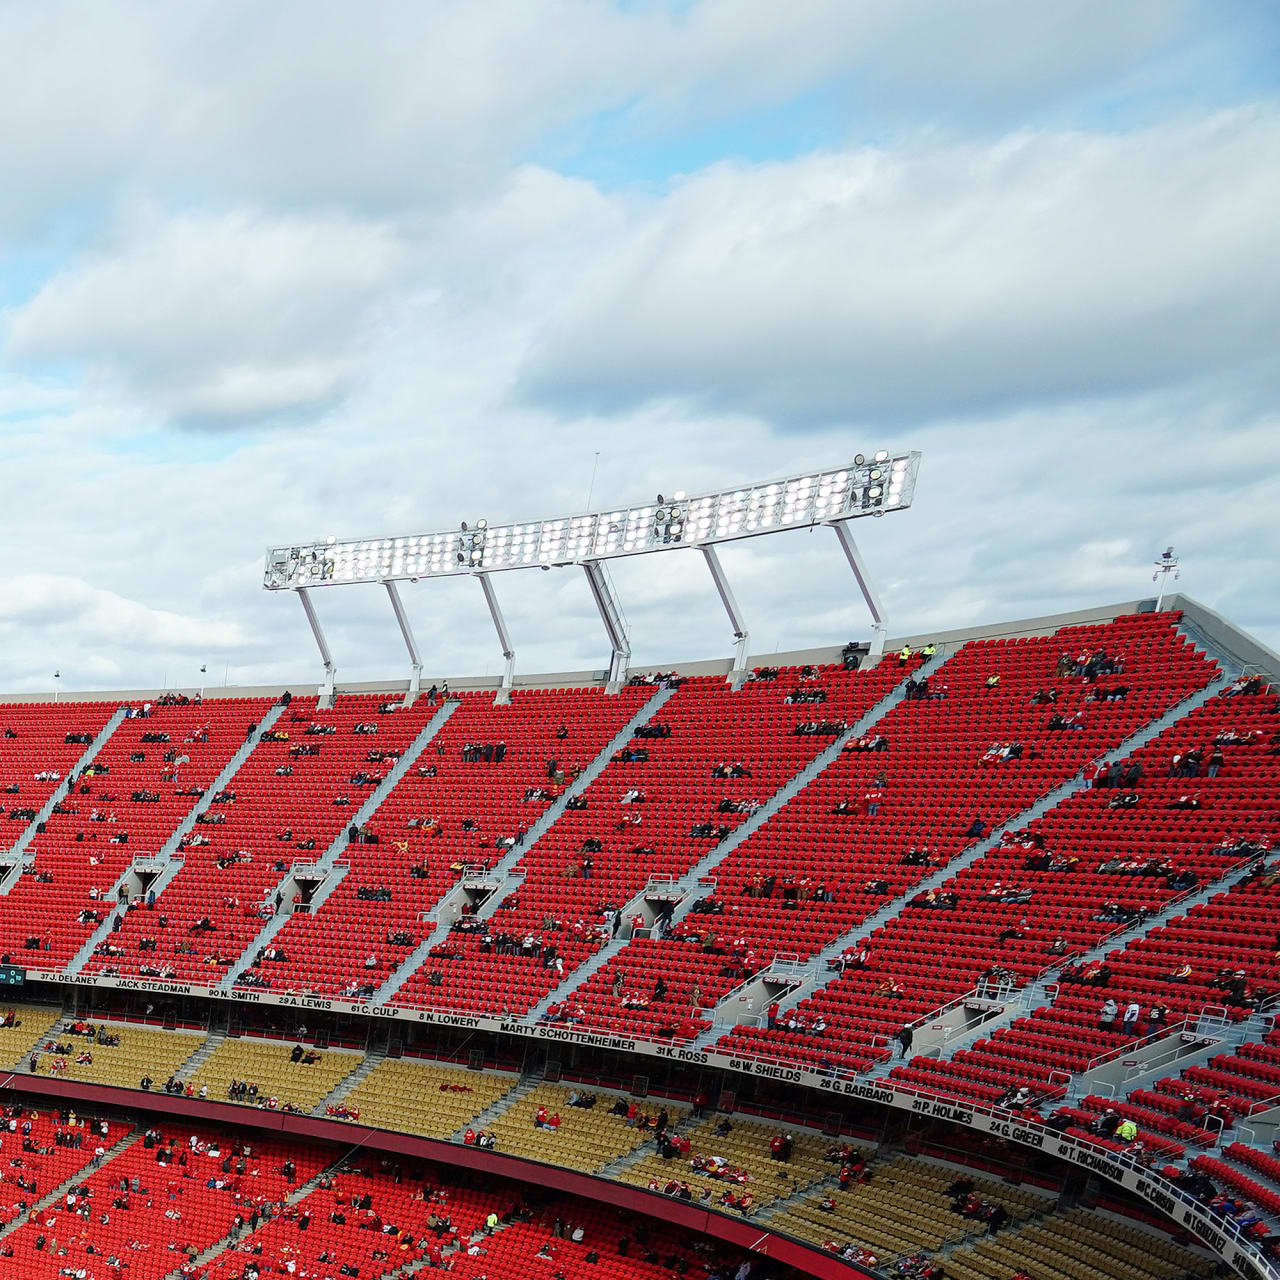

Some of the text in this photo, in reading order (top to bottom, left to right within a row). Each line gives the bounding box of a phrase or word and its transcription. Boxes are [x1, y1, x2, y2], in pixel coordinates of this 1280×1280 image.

[58, 975, 98, 985] DELANEY
[116, 980, 191, 994] JACK STEADMAN
[209, 989, 260, 1002] 90 N. SMITH
[290, 998, 300, 1006] A.
[301, 998, 332, 1009] LEWIS
[361, 1006, 371, 1014] C.
[372, 1006, 399, 1017] CULP
[426, 1013, 436, 1022] N.
[438, 1014, 480, 1027] LOWERY
[500, 1023, 636, 1050] MARTY SCHOTTENHEIMER
[667, 1048, 677, 1057] K.
[678, 1049, 708, 1063] ROSS
[729, 1059, 801, 1082] 68 W. SHIELDS
[820, 1078, 894, 1103] 26 G. BARBARO
[922, 1102, 931, 1113] P.
[932, 1104, 973, 1124] HOLMES
[989, 1121, 1044, 1147] 24 G. GREEN
[1077, 1151, 1124, 1183] RICHARDSON
